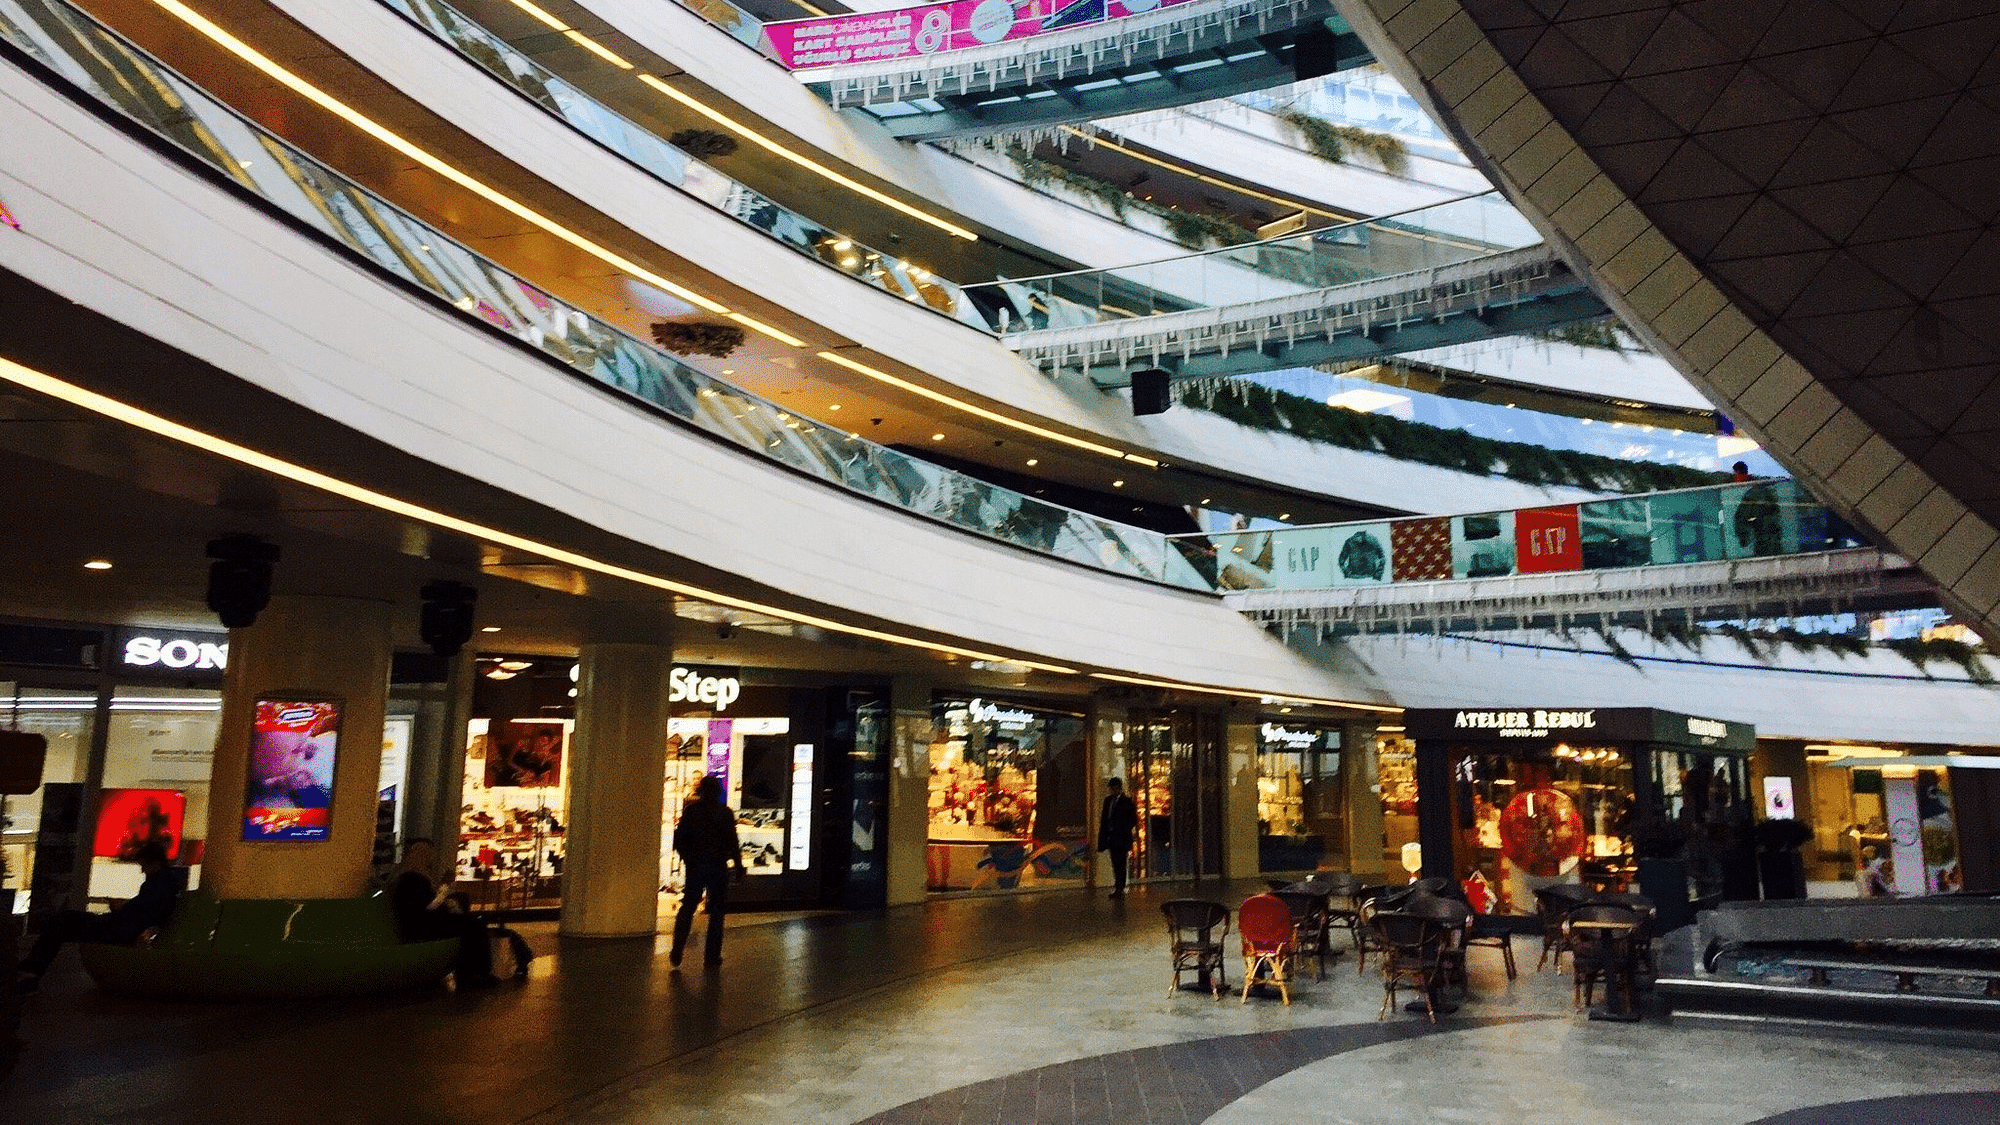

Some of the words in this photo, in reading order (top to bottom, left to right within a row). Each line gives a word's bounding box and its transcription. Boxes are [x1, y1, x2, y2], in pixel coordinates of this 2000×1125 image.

[1530, 526, 1566, 557] GAP
[1288, 546, 1320, 573] GAP
[1454, 710, 1529, 728] ATELIER
[1533, 709, 1596, 728] REBUL
